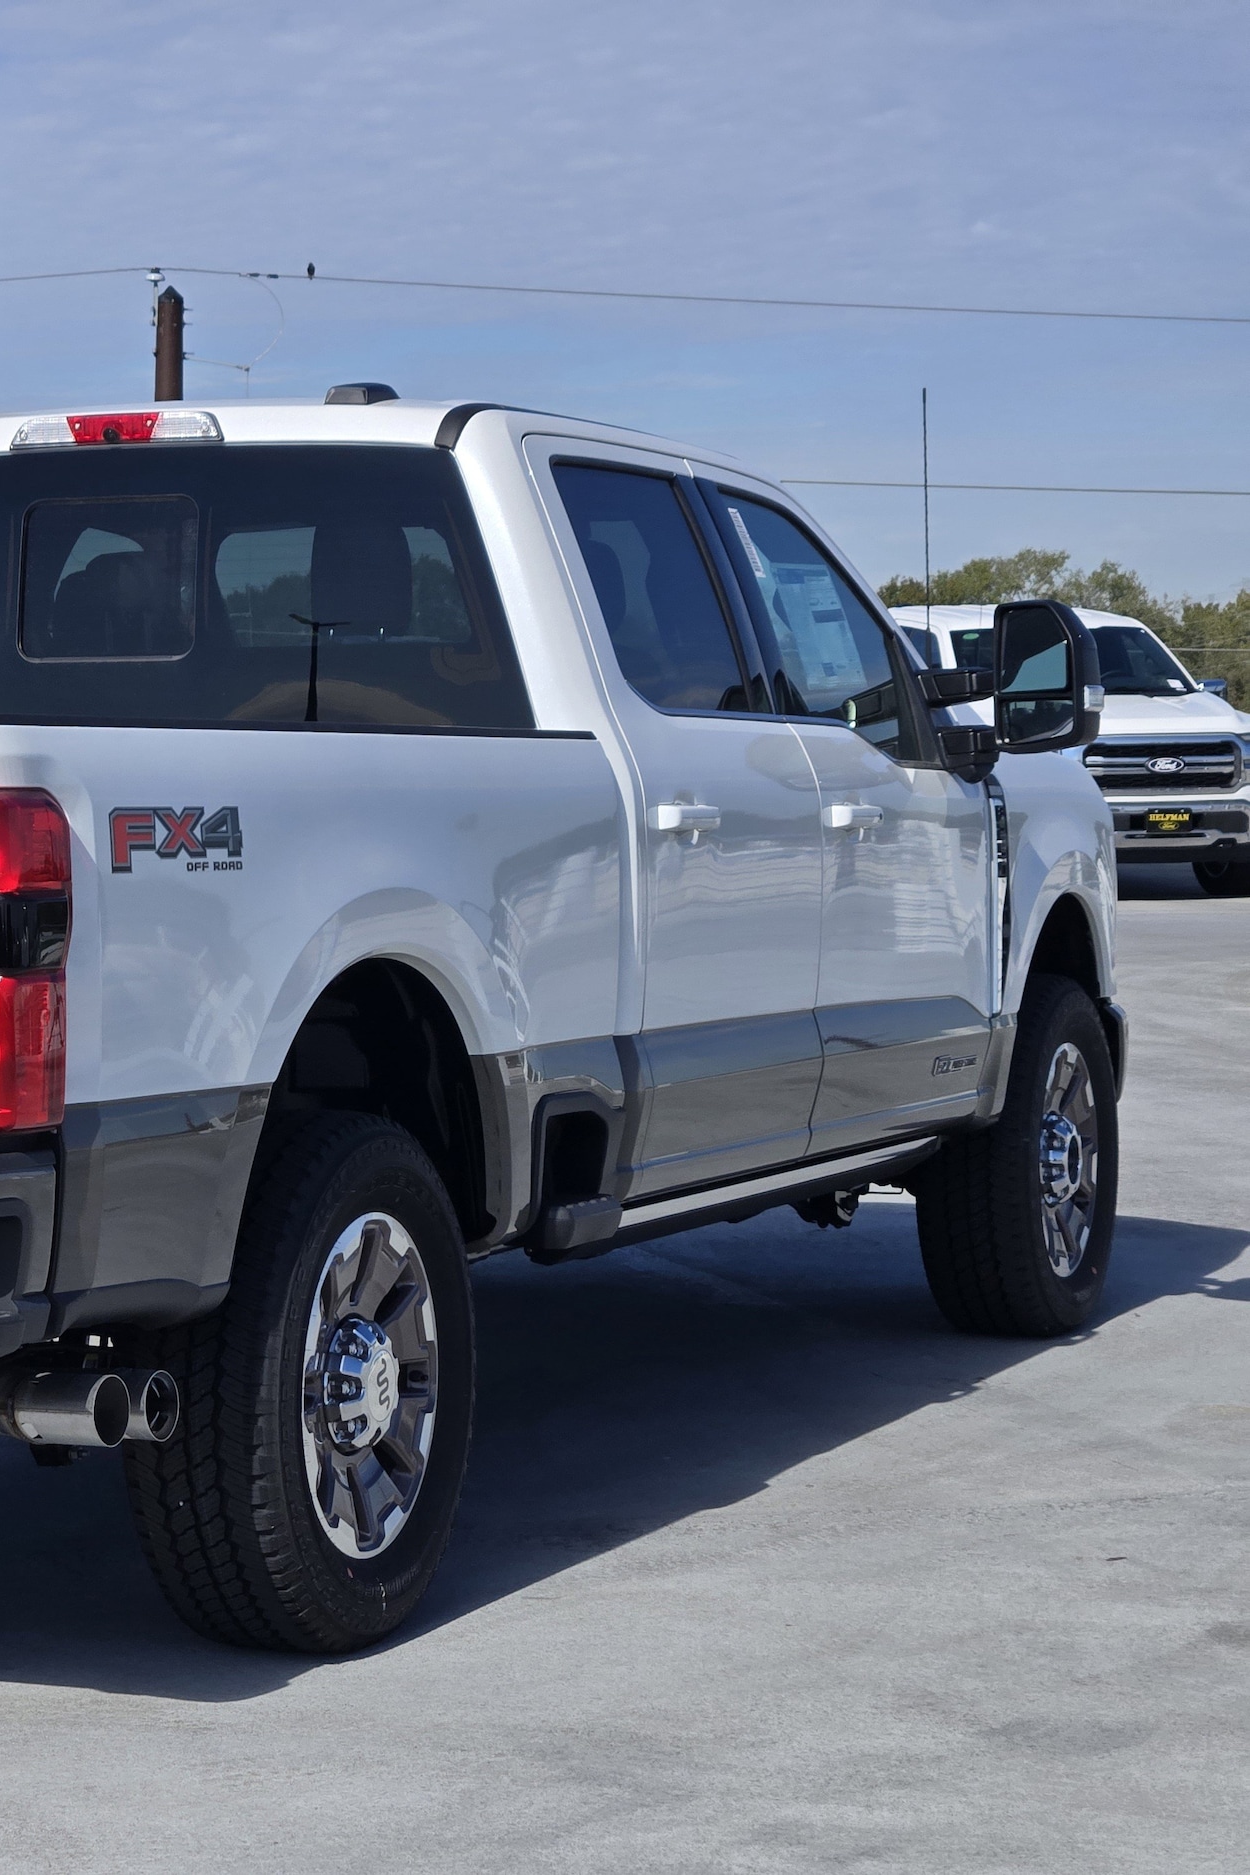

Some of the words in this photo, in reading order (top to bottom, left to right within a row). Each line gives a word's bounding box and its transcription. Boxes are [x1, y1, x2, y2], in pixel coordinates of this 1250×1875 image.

[108, 806, 243, 874] FX4
[186, 862, 209, 872] OFF
[213, 861, 243, 871] ROAD
